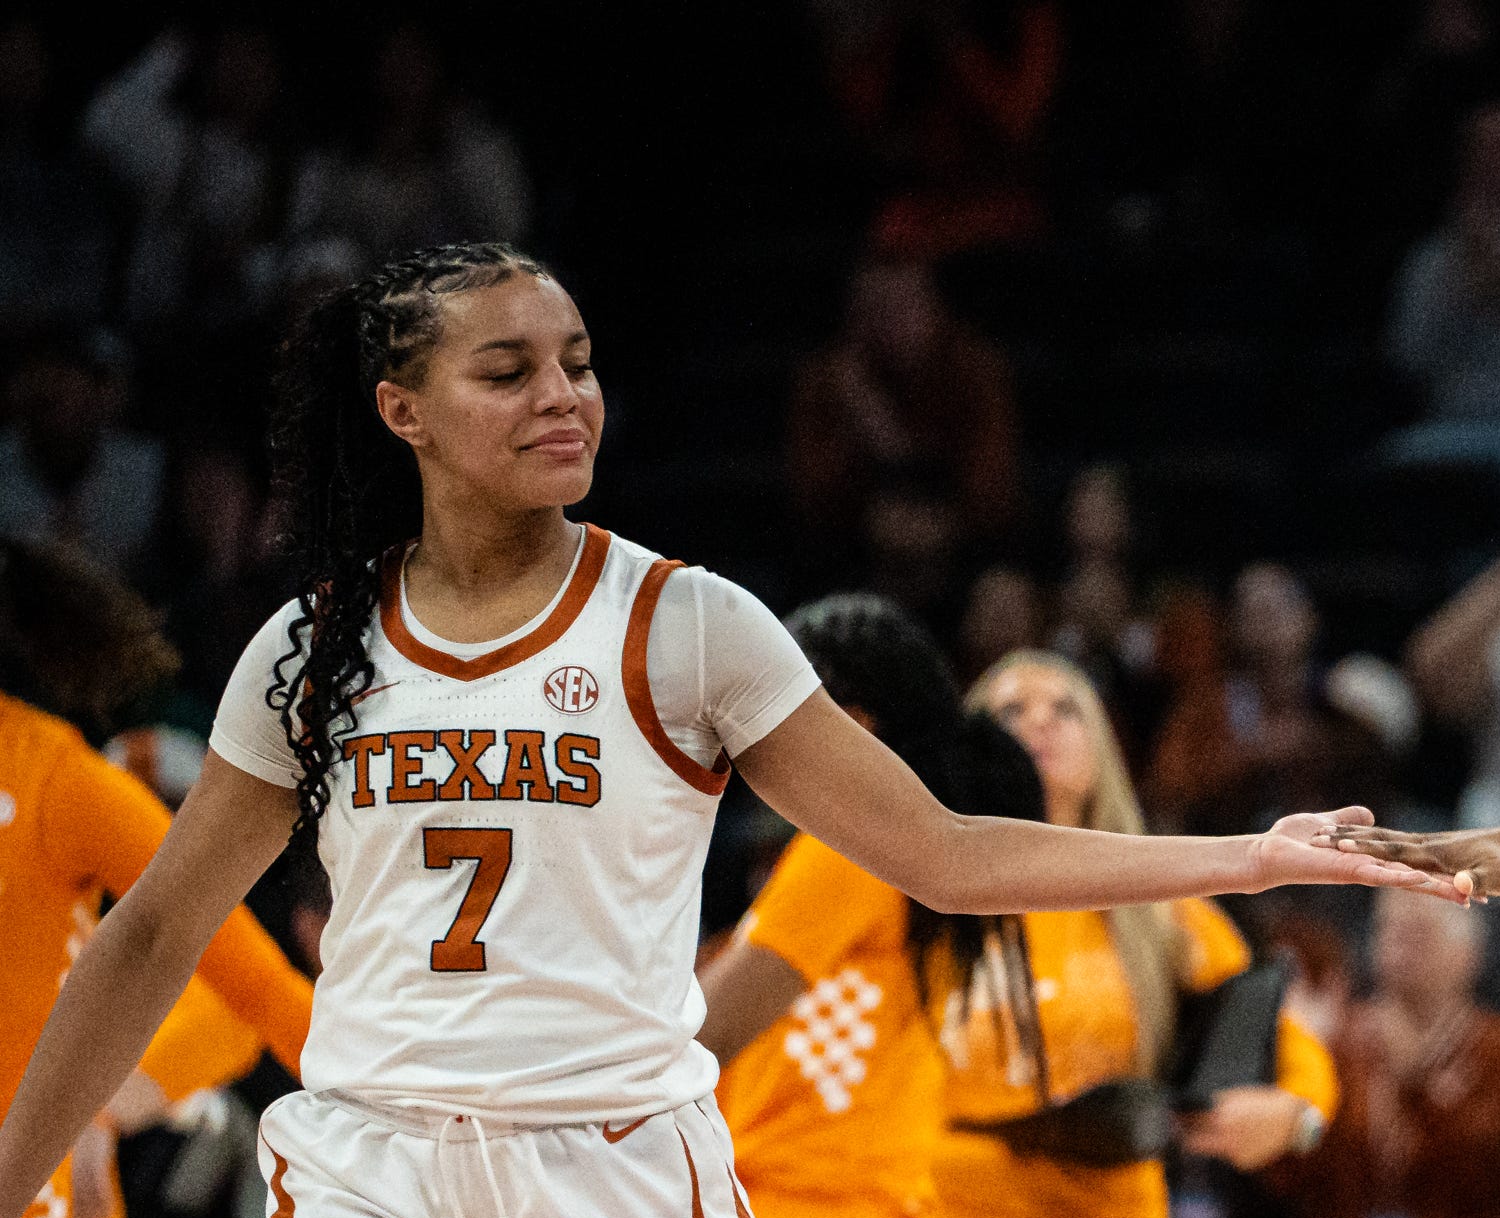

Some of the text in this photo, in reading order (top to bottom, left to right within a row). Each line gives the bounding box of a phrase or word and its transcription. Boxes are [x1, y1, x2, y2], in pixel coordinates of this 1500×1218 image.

[544, 666, 598, 713] SEC
[342, 729, 601, 809] TEXAS
[423, 827, 513, 973] 7
